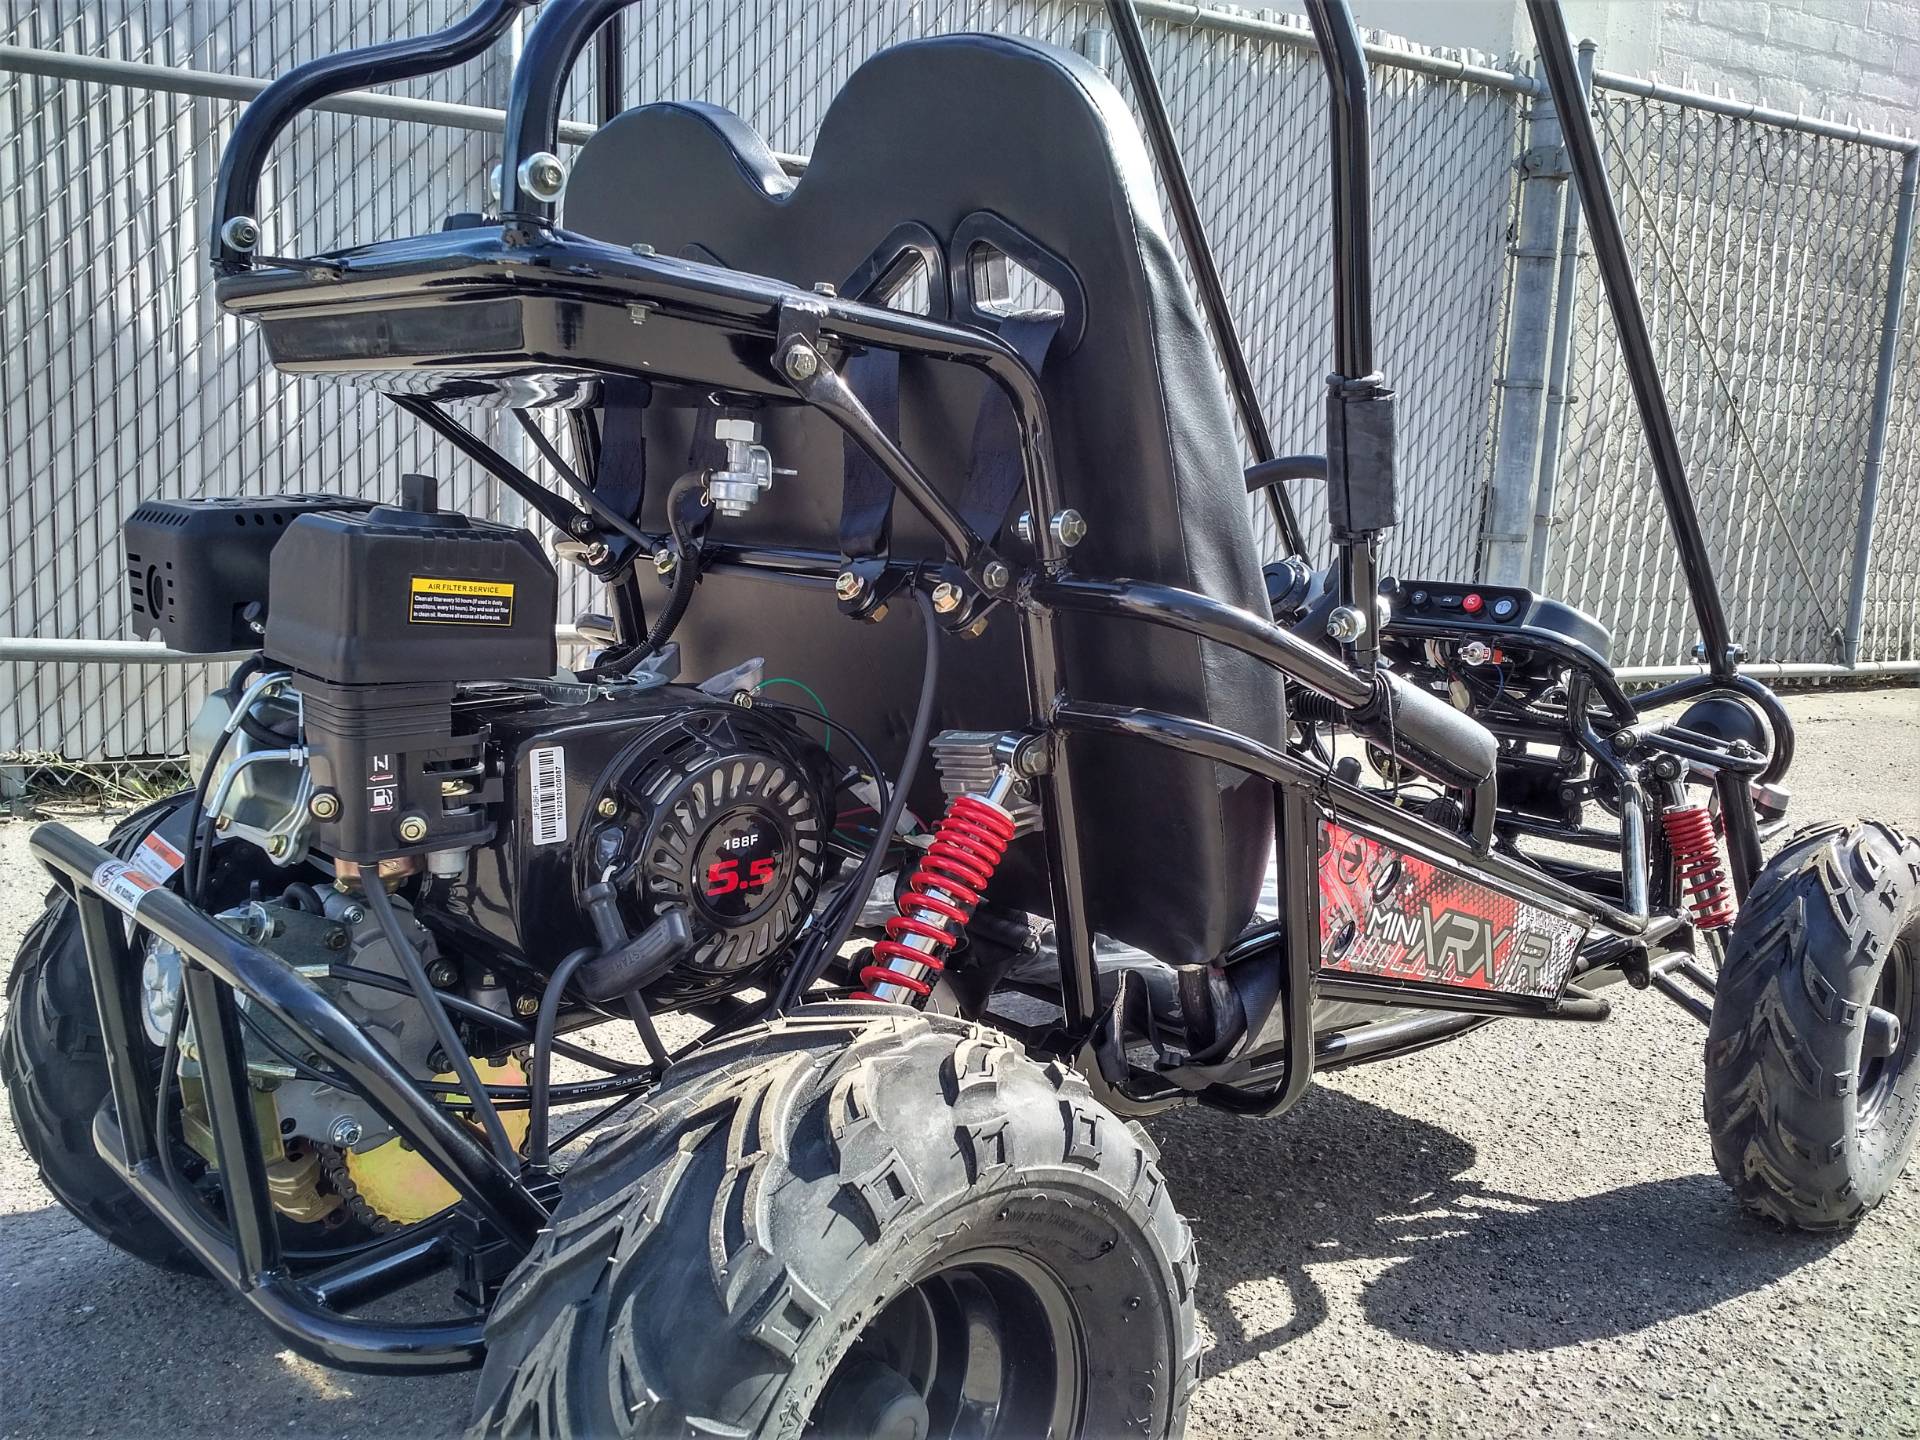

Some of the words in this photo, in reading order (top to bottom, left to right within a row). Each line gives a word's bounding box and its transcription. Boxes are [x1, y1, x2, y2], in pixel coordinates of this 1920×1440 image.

[724, 834, 758, 850] 168F
[706, 857, 774, 897] 5.5
[1366, 908, 1422, 946] MINI
